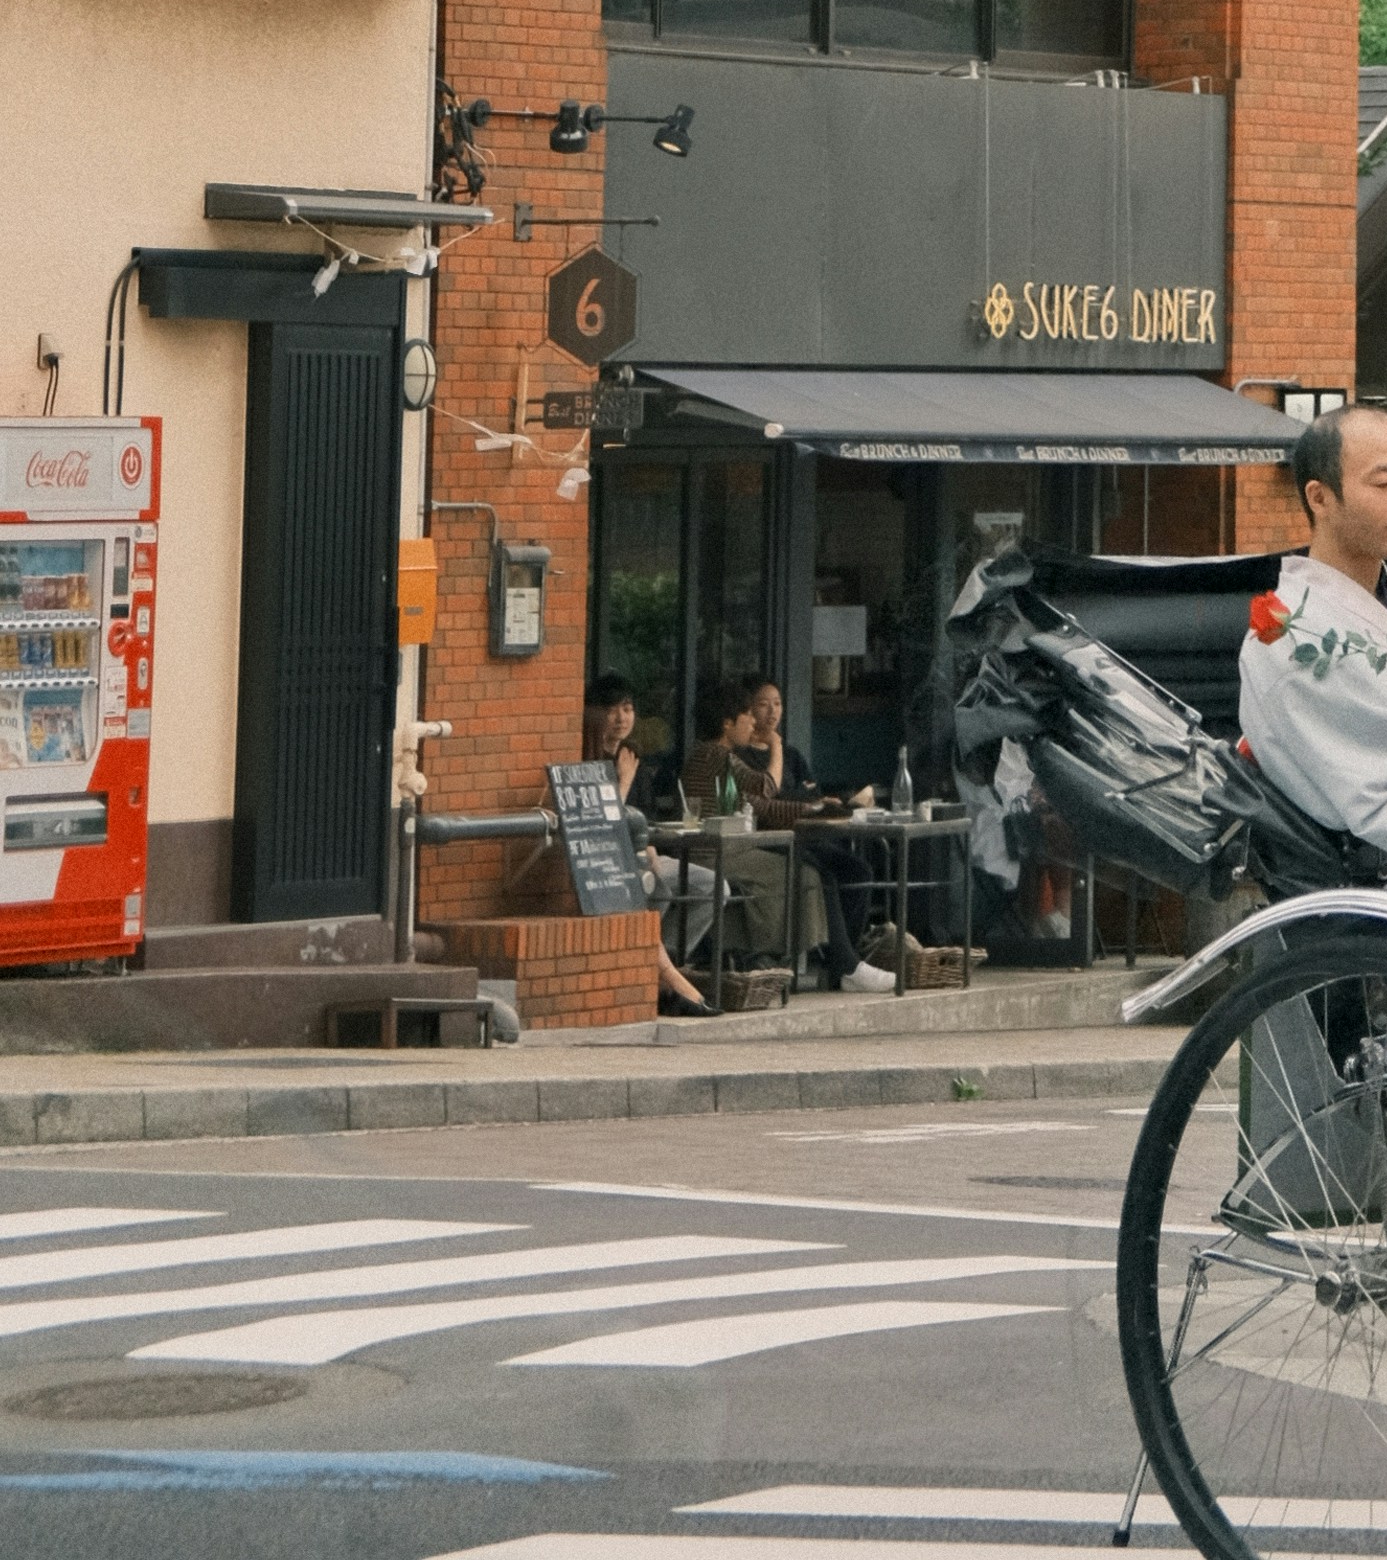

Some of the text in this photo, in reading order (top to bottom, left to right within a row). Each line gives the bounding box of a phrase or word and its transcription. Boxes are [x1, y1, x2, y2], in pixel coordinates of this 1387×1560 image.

[575, 277, 606, 337] 6
[1020, 281, 1217, 344] SUKE6 DINER
[860, 444, 911, 459] BRUNCH
[918, 444, 963, 460] DINNER
[1088, 447, 1131, 462] DINNER
